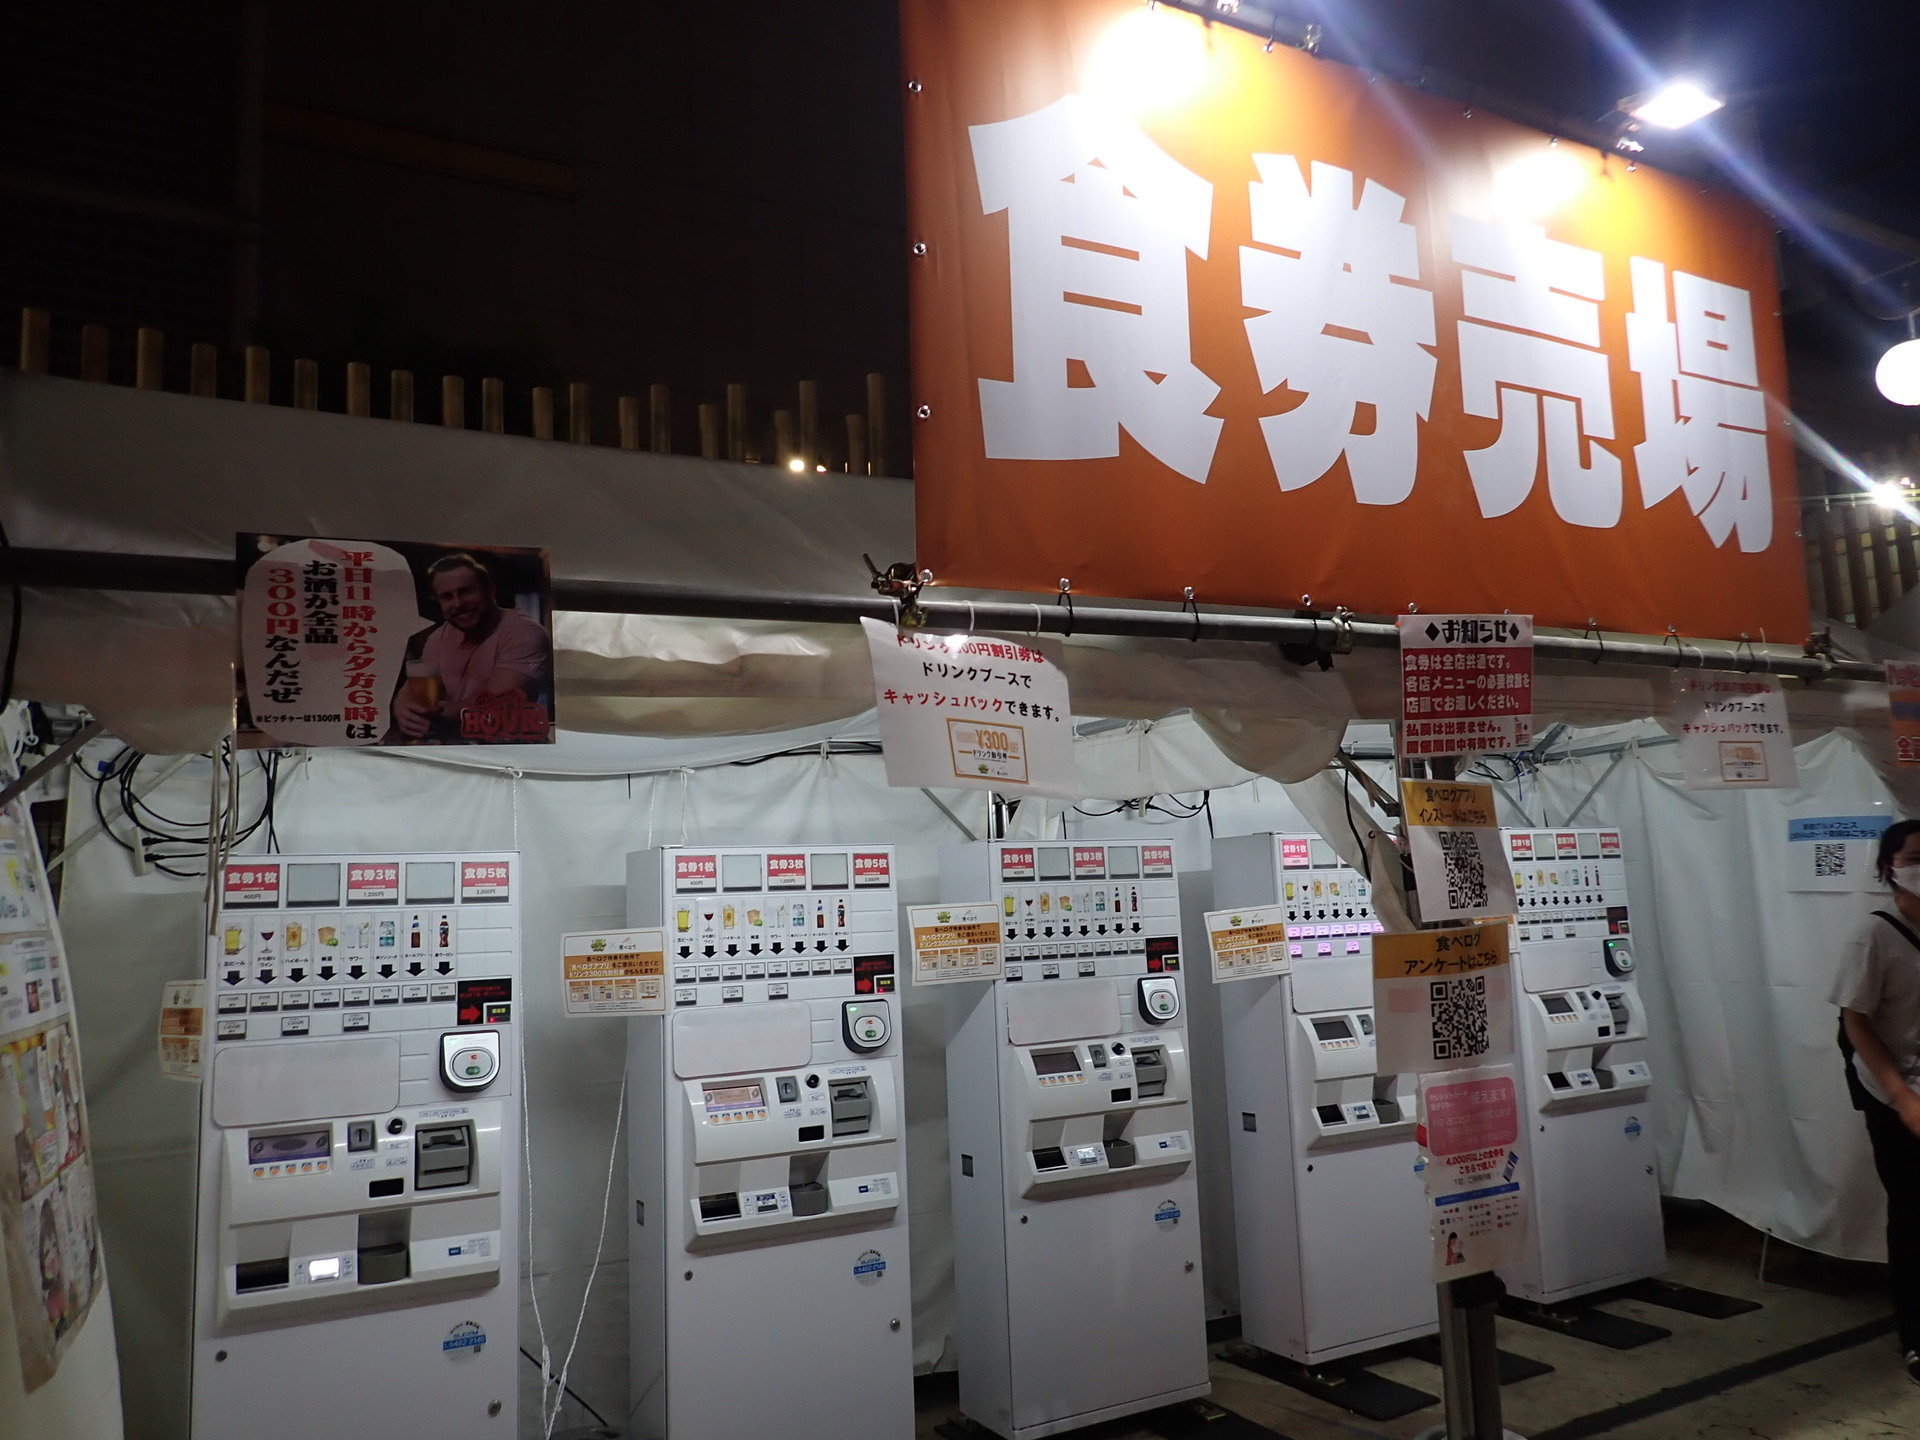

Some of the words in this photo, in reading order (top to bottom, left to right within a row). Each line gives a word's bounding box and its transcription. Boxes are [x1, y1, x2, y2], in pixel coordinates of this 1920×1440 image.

[968, 93, 1774, 554] 食券売場
[303, 559, 339, 645] お酒が全品
[264, 568, 303, 704] 300円なんだぜ
[342, 550, 379, 739] 平日11時から夕方6時は
[922, 661, 1032, 689] ドリンクブースで
[884, 688, 1060, 722] キャッシュバックできます。
[351, 868, 397, 881] 食券3枚
[464, 866, 507, 879] 食券5枚
[677, 861, 715, 873] 食券1枚
[769, 859, 804, 870] 食券3枚
[854, 858, 888, 869] 食券5枚
[228, 871, 278, 885] 食券1枚
[1436, 930, 1481, 952] 食べログ
[1404, 949, 1498, 975] アンケートはこちら
